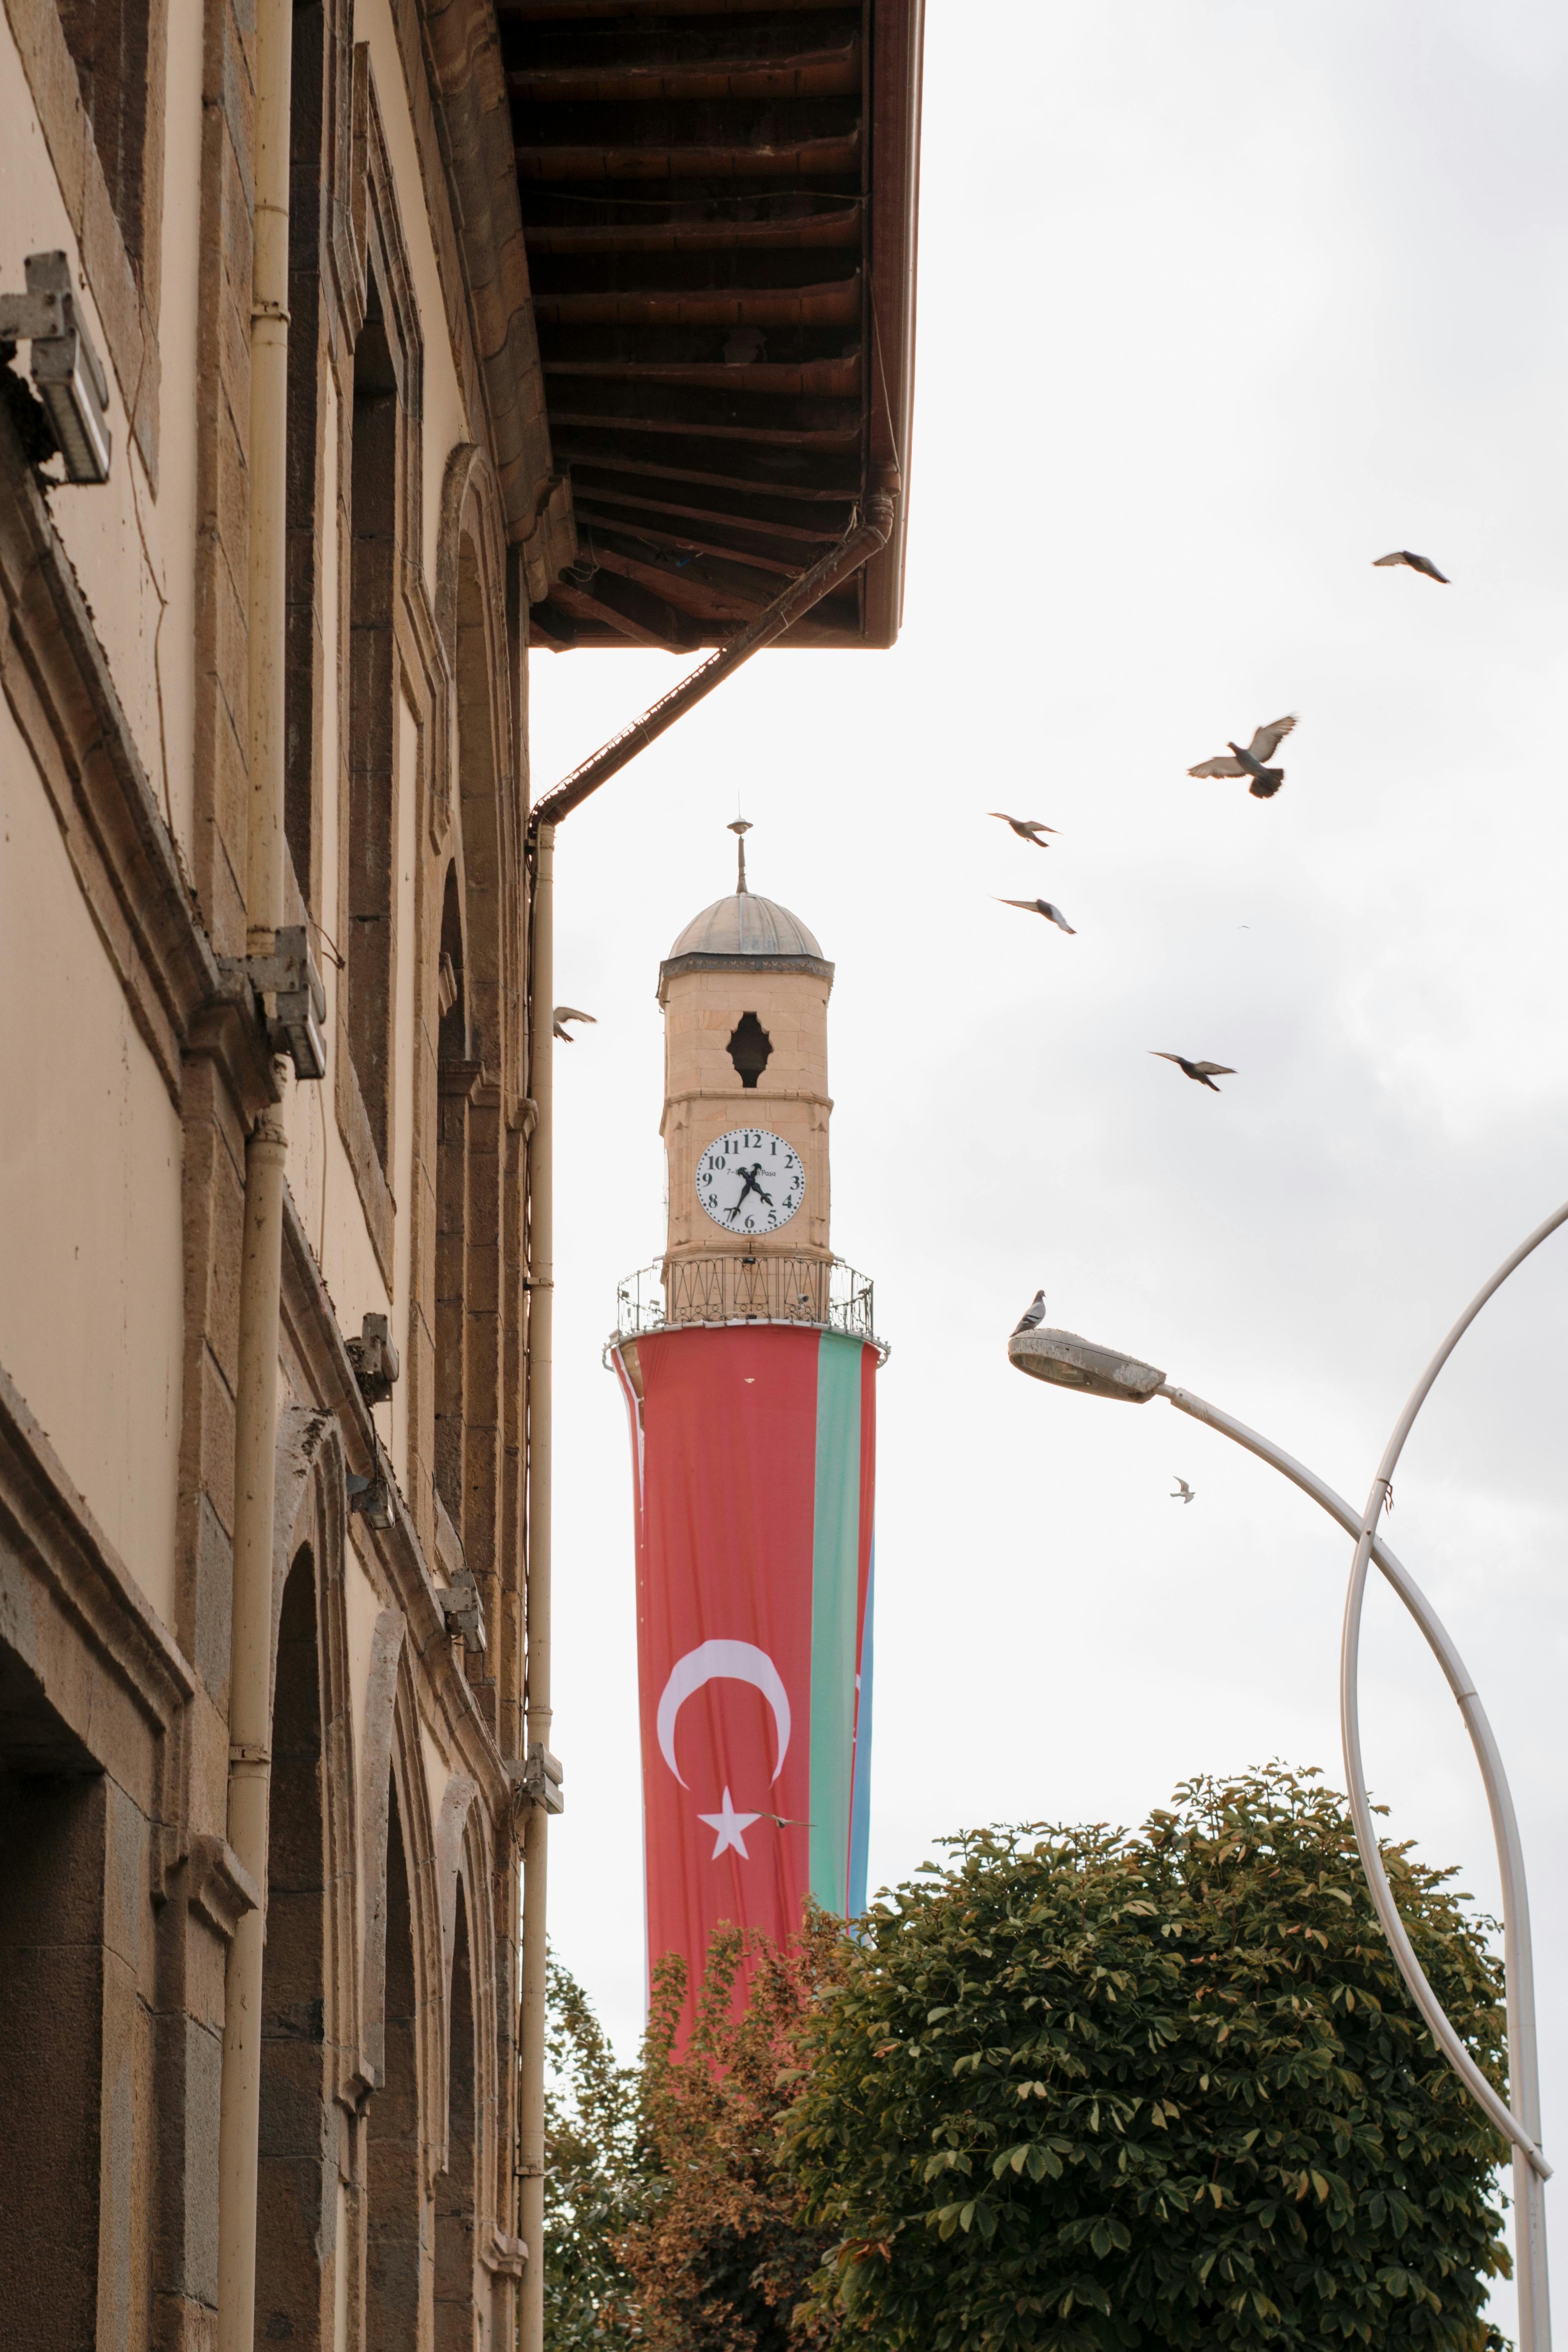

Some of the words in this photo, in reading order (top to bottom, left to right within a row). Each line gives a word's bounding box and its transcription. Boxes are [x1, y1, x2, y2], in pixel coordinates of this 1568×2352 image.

[723, 1140, 739, 1154] 11
[743, 1134, 762, 1148] 12
[770, 1141, 777, 1156] 1
[707, 1156, 726, 1170] 10
[784, 1154, 793, 1169] 2
[702, 1173, 713, 1187] 9
[790, 1176, 800, 1190] 3
[708, 1194, 718, 1208] 8
[782, 1194, 793, 1209] 4
[723, 1208, 734, 1222] 7
[744, 1214, 755, 1229] 6
[767, 1209, 777, 1224] 5
